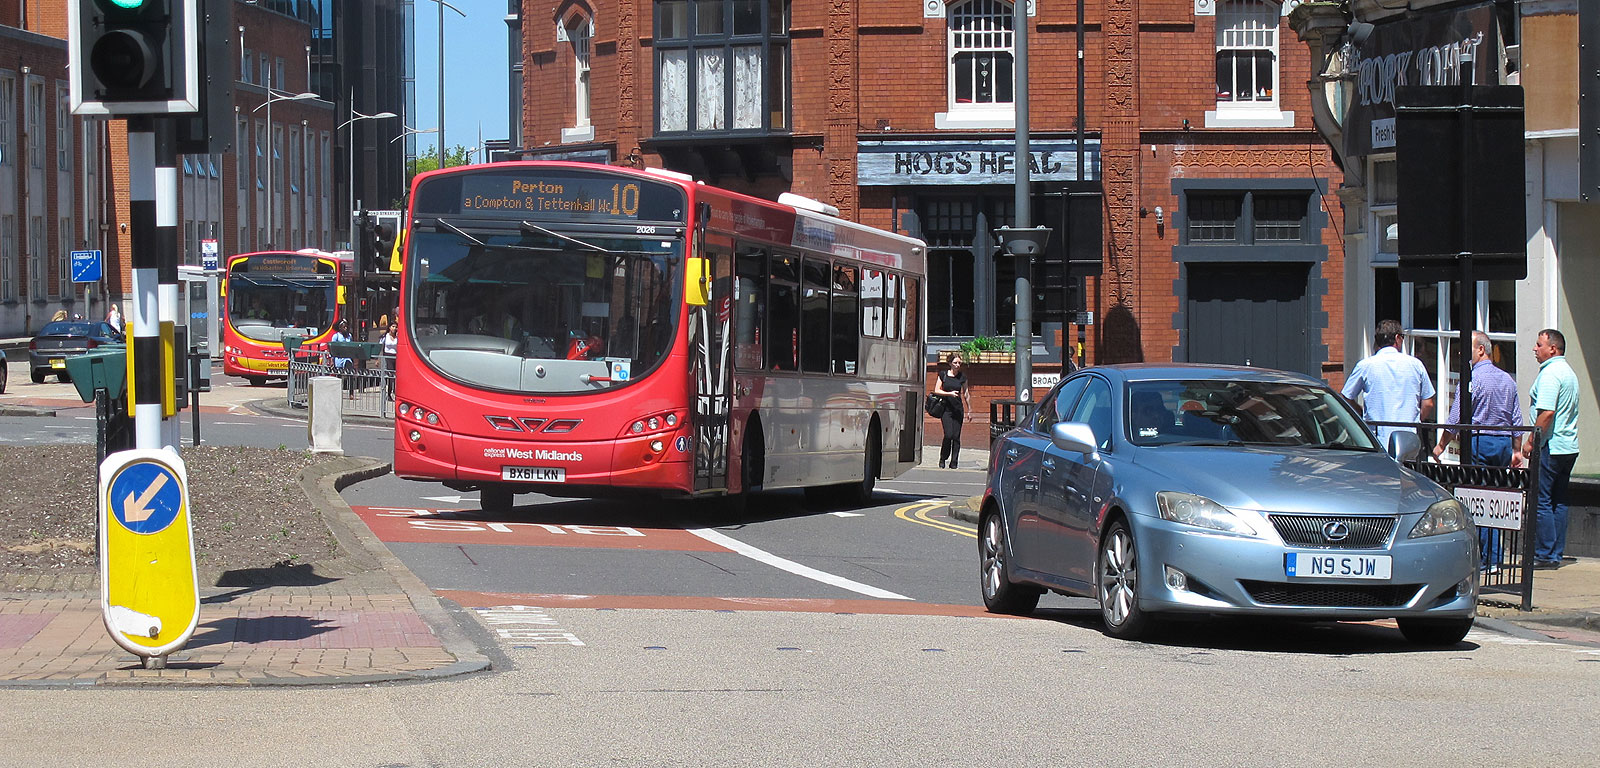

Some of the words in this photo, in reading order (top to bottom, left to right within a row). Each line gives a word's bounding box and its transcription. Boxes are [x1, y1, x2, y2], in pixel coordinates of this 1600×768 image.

[1358, 50, 1413, 110] PORK
[1375, 124, 1391, 142] Fresh
[894, 151, 973, 175] HOGS
[512, 180, 564, 194] Perton
[474, 195, 522, 210] Compton
[525, 196, 534, 211] &
[537, 197, 595, 212] Tettenhall
[611, 183, 640, 216] 10
[636, 226, 656, 234] 2026
[311, 259, 318, 273] 3
[1032, 376, 1058, 385] BROAD
[506, 448, 533, 459] West
[535, 449, 583, 462] Midlands
[509, 468, 534, 479] BX61
[536, 469, 559, 480] LKN
[1489, 499, 1520, 521] SQUARE
[1311, 556, 1336, 575] N9
[1340, 557, 1377, 576] SJW
